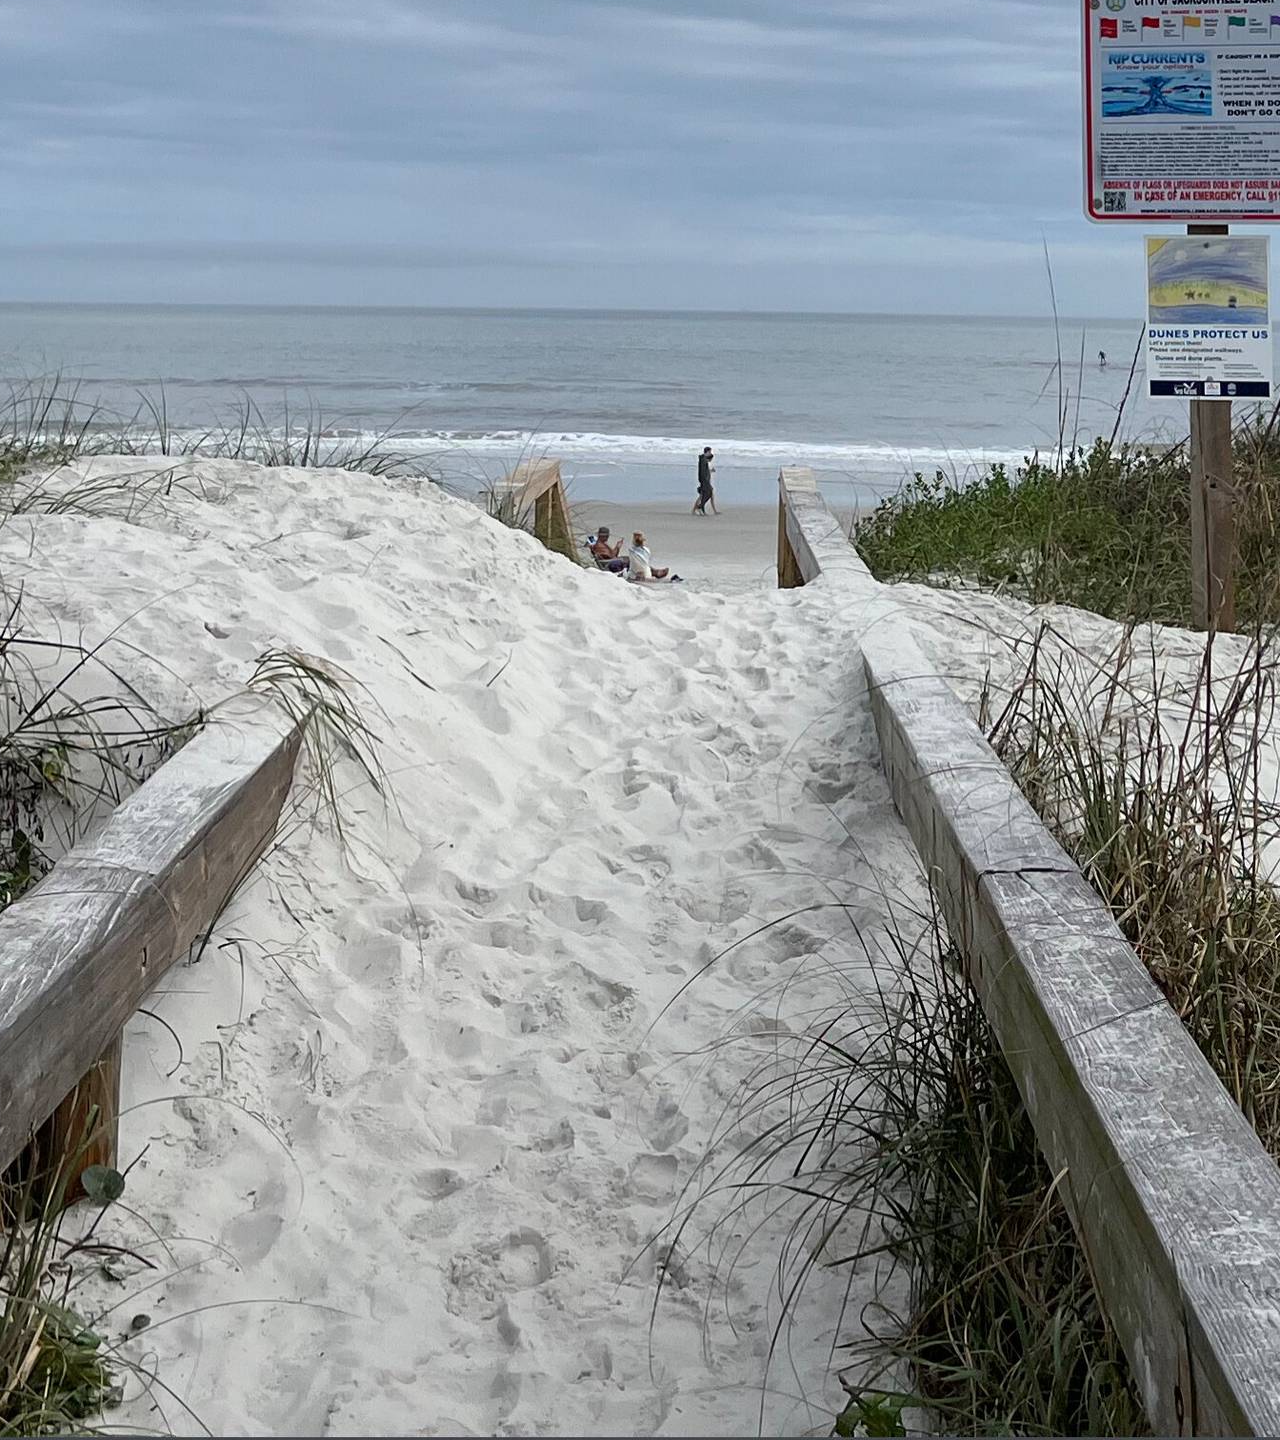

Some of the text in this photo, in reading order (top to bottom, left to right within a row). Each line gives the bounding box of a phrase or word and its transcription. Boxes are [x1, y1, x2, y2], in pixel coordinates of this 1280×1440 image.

[1108, 52, 1206, 65] RIP CURRENTS
[1134, 191, 1143, 201] IN
[1144, 191, 1165, 201] CASE
[1167, 191, 1177, 201] OF
[1180, 191, 1191, 201] AN
[1193, 191, 1245, 202] EMERGENCY,
[1246, 191, 1266, 201] CALL
[1148, 329, 1269, 339] DUNES PROTECT US
